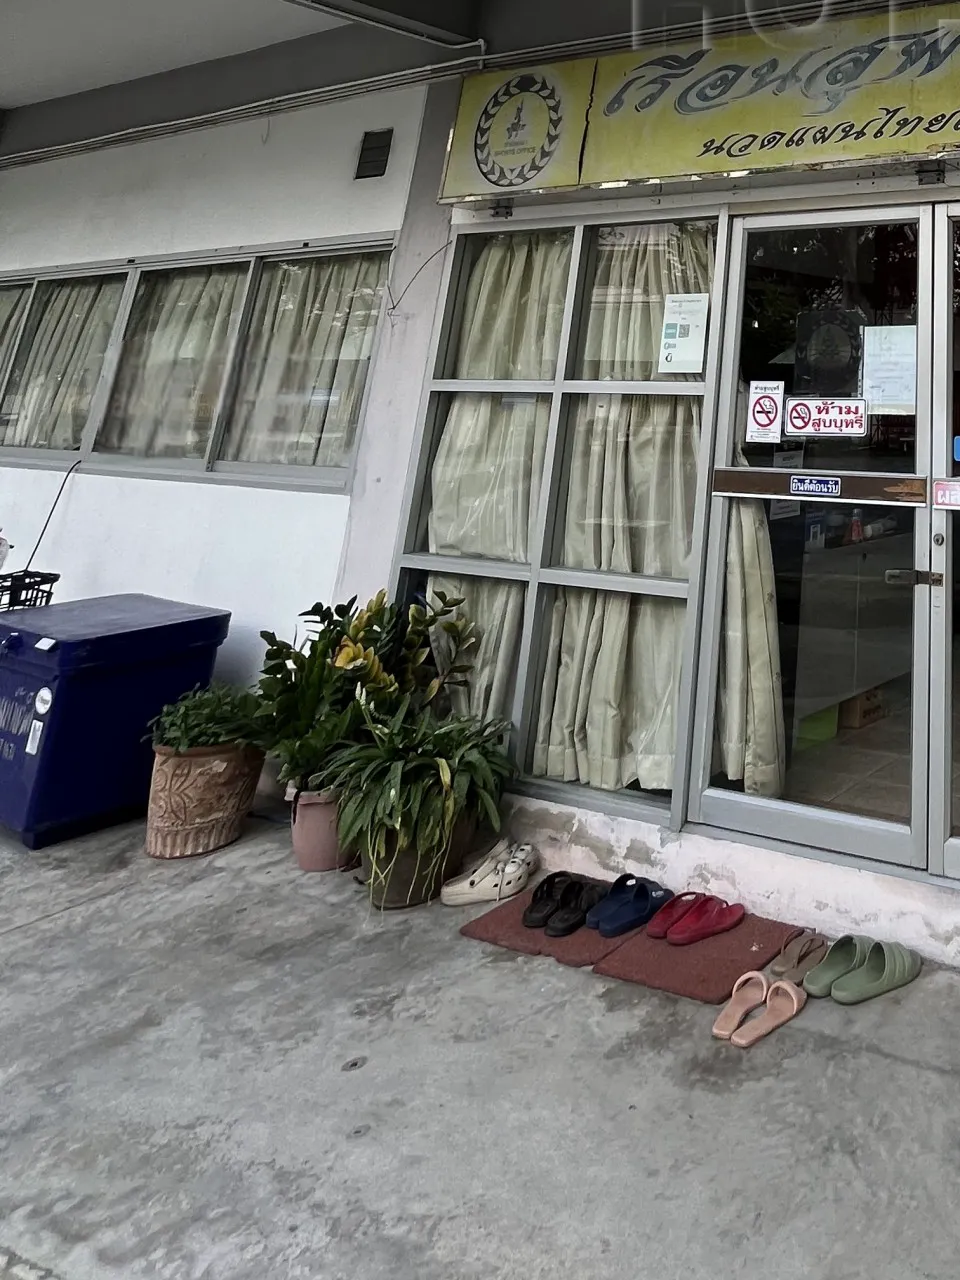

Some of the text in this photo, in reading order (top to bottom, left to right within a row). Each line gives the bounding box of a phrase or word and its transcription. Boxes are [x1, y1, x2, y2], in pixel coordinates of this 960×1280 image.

[815, 401, 860, 415] ห้าม
[811, 412, 864, 432] สูบบุหรี่
[792, 479, 839, 493] ยินดีต้อนรับ
